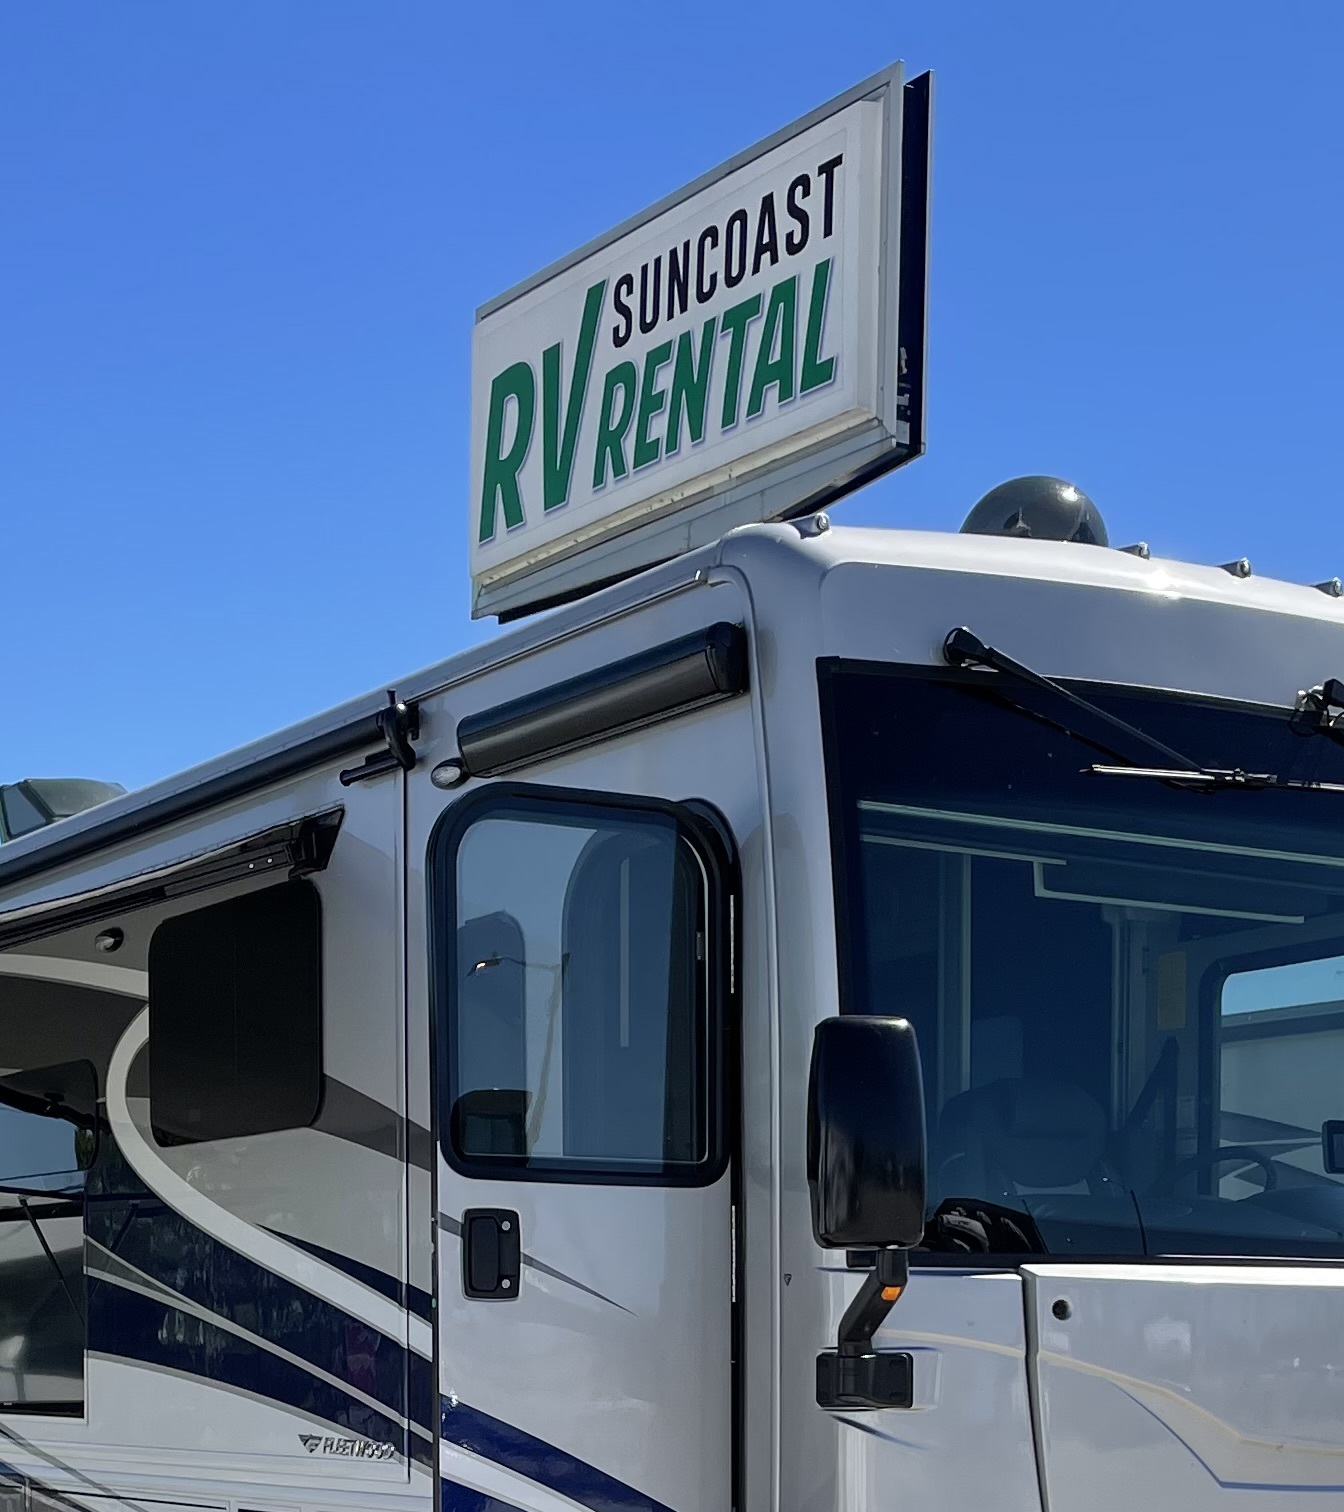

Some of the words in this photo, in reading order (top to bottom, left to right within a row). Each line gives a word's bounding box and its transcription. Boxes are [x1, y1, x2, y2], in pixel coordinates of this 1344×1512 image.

[612, 153, 844, 348] SUNCOAST
[478, 279, 607, 542] RV
[592, 257, 838, 490] RENTAL
